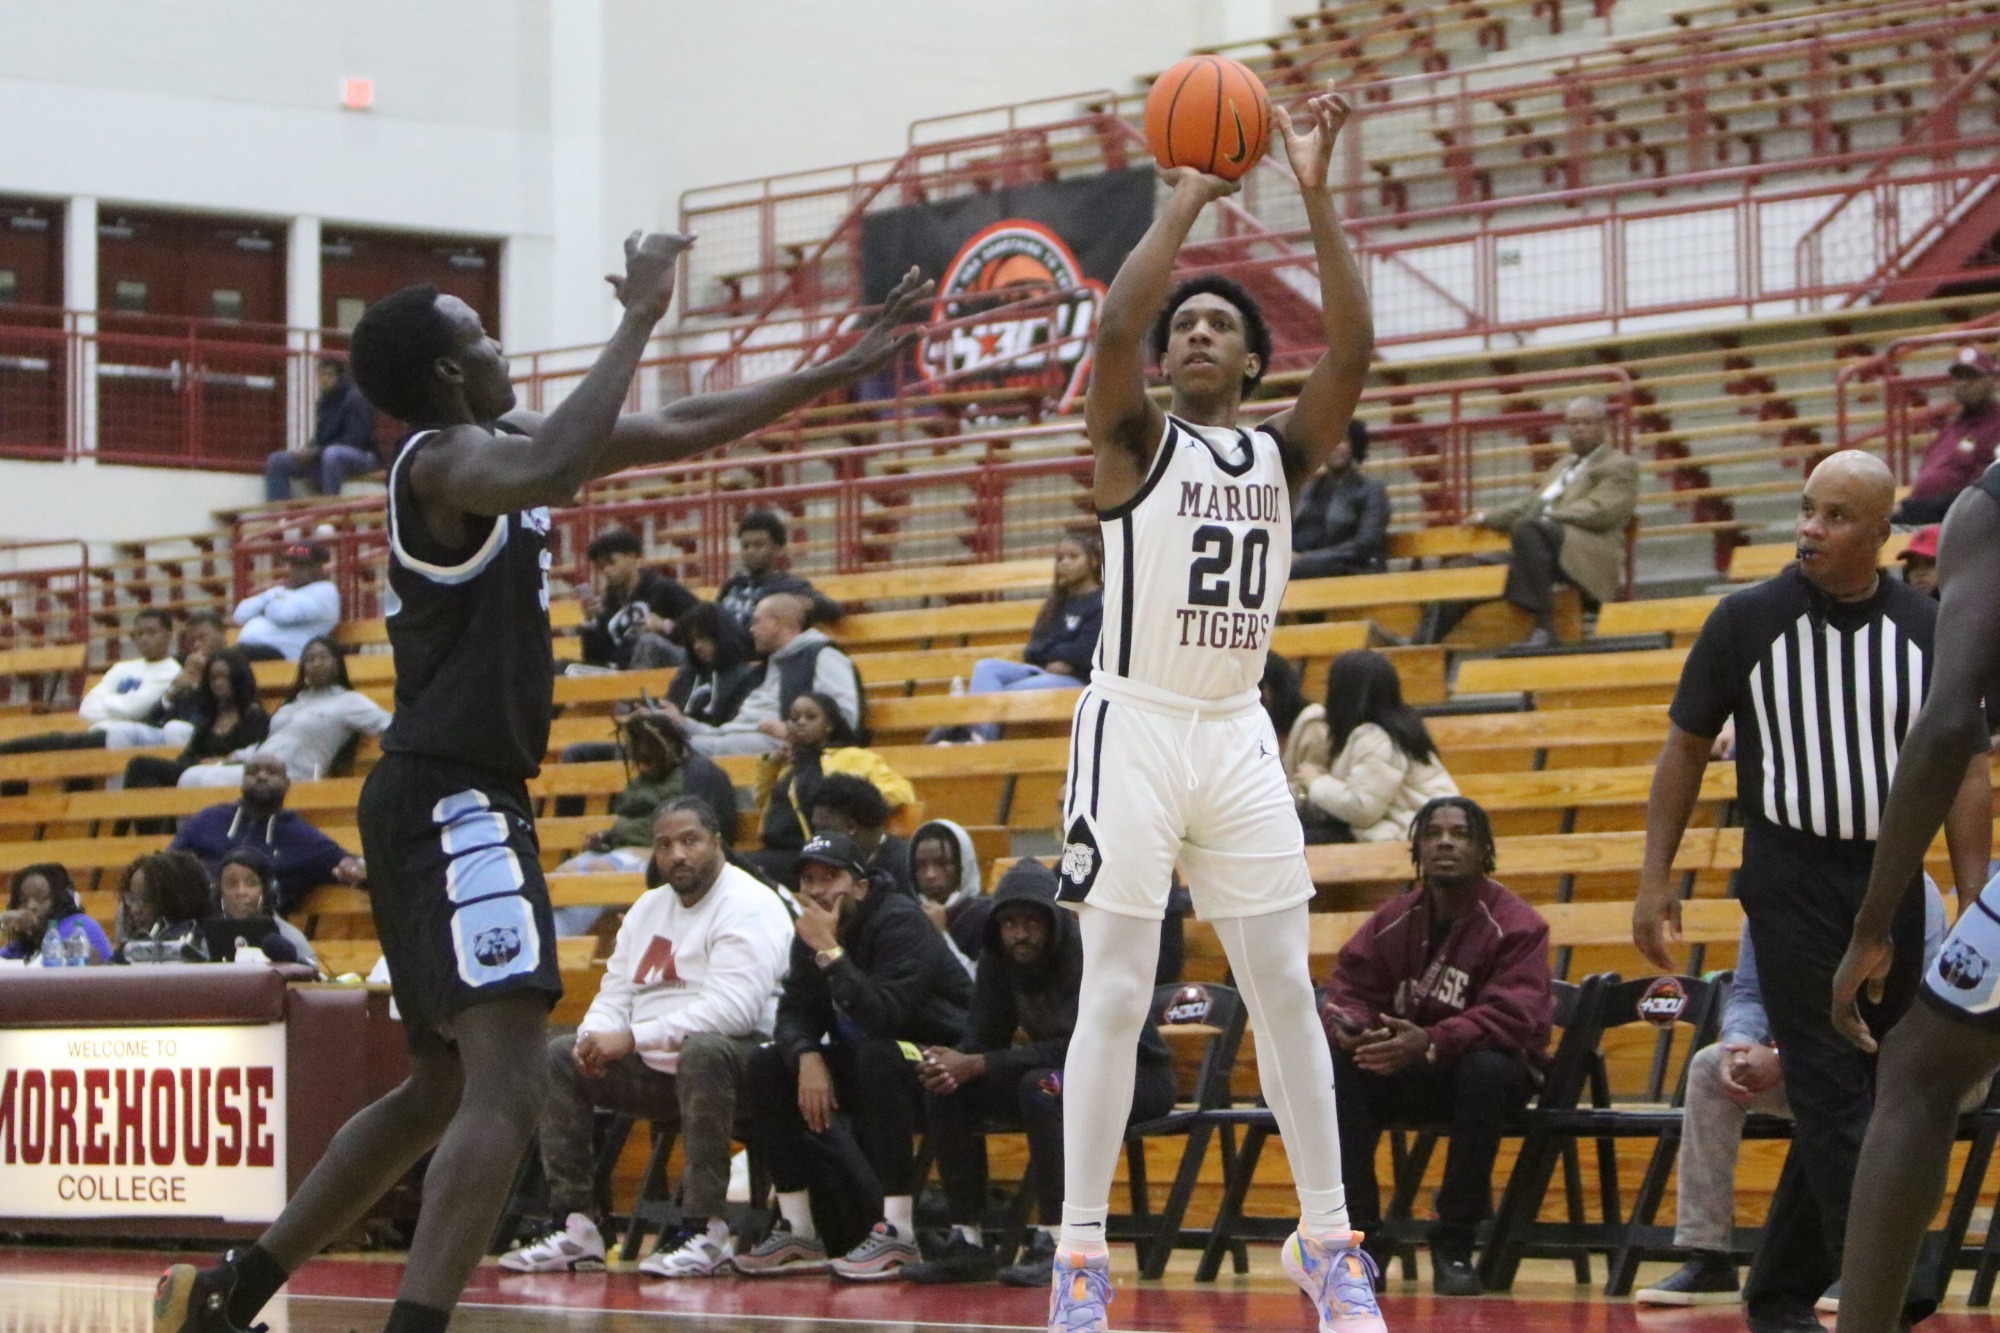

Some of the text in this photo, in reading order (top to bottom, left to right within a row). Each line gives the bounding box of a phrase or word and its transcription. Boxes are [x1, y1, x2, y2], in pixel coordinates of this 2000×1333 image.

[1188, 525, 1269, 609] 20
[1176, 609, 1269, 650] TIGERS
[68, 1040, 177, 1057] WELCOME TO
[58, 1175, 186, 1202] COLLEGE
